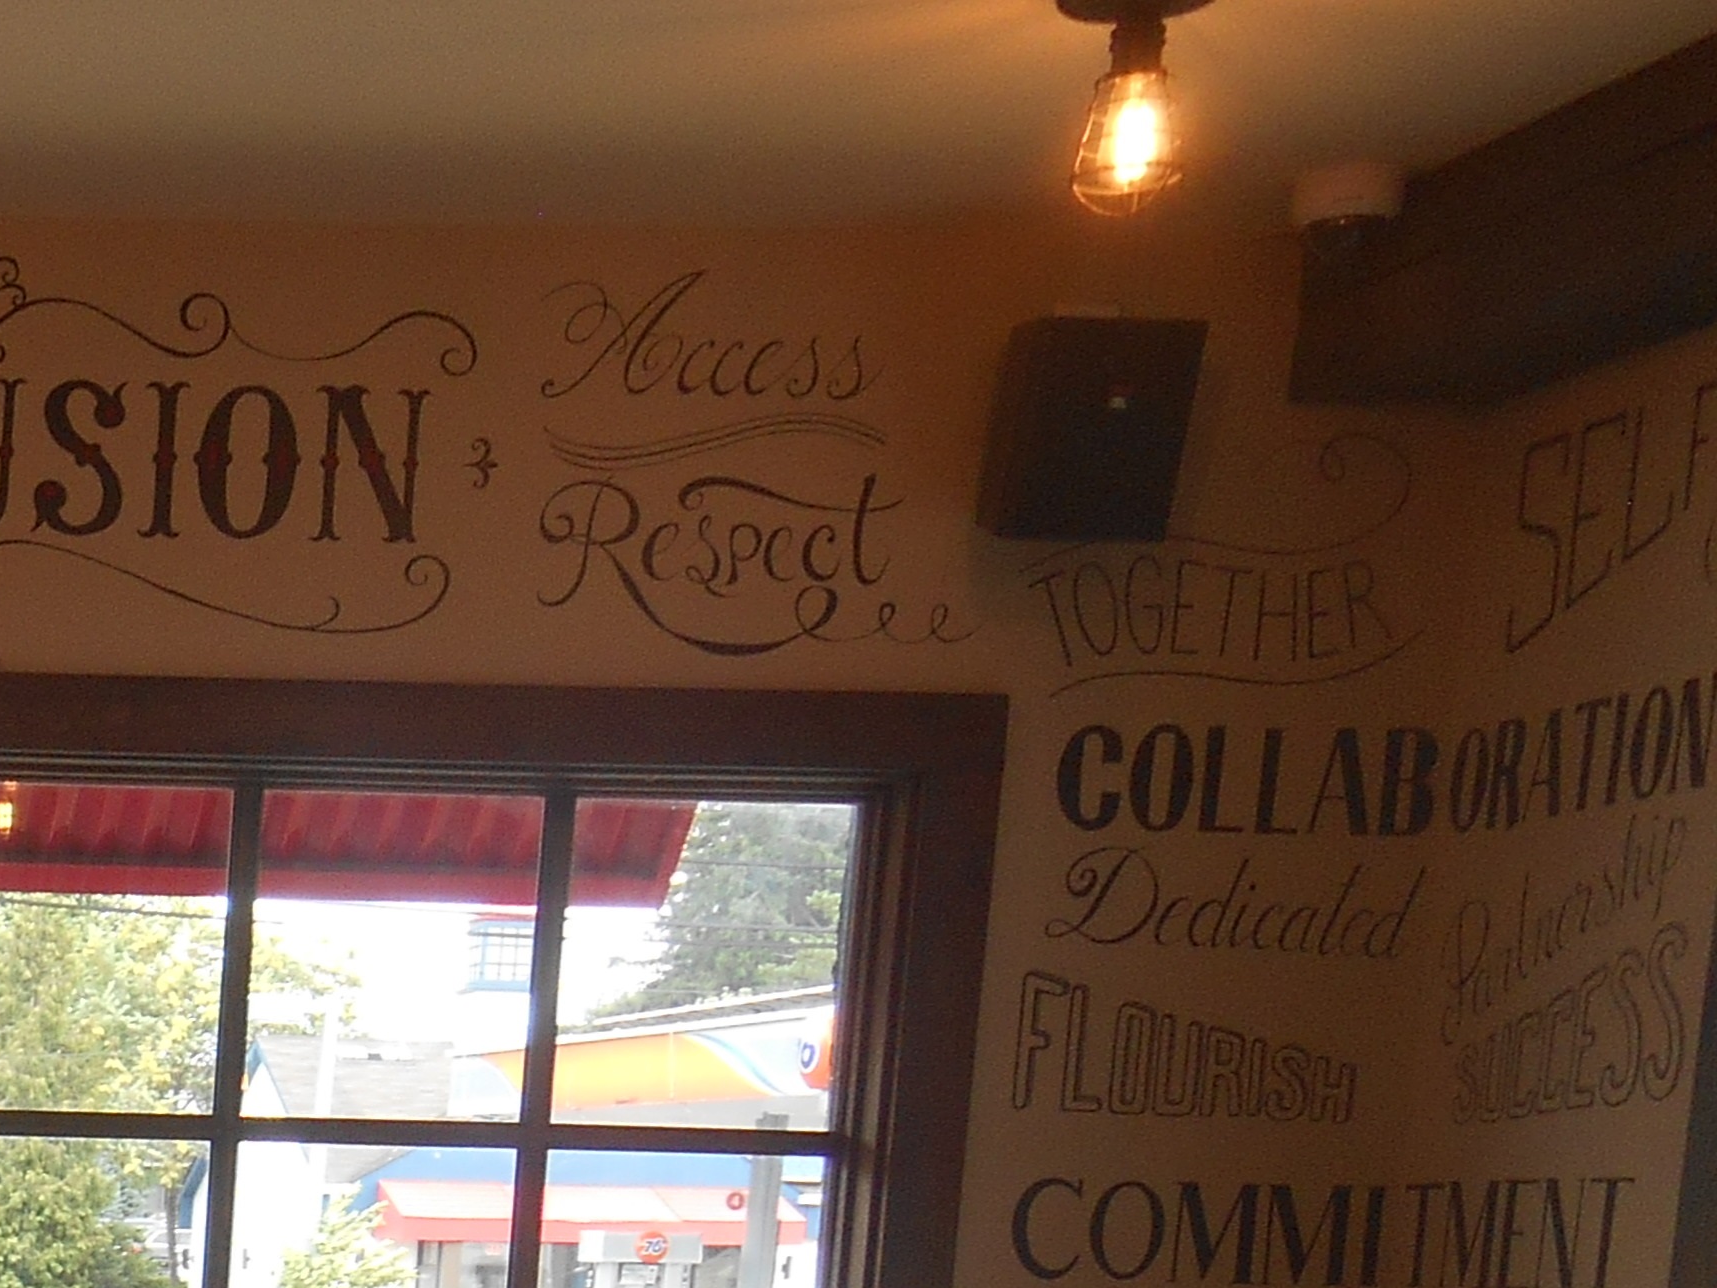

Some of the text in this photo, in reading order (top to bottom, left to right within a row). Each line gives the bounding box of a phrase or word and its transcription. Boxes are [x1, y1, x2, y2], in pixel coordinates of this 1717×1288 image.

[540, 268, 873, 400] Access
[538, 472, 905, 640] Respect
[1027, 552, 1395, 667] TOGETHER
[1056, 668, 1717, 838] COLLABORATION
[1043, 846, 1426, 960] Dedicated
[1011, 968, 1358, 1125] FLOURISH
[1450, 921, 1689, 1125] SUCCESS
